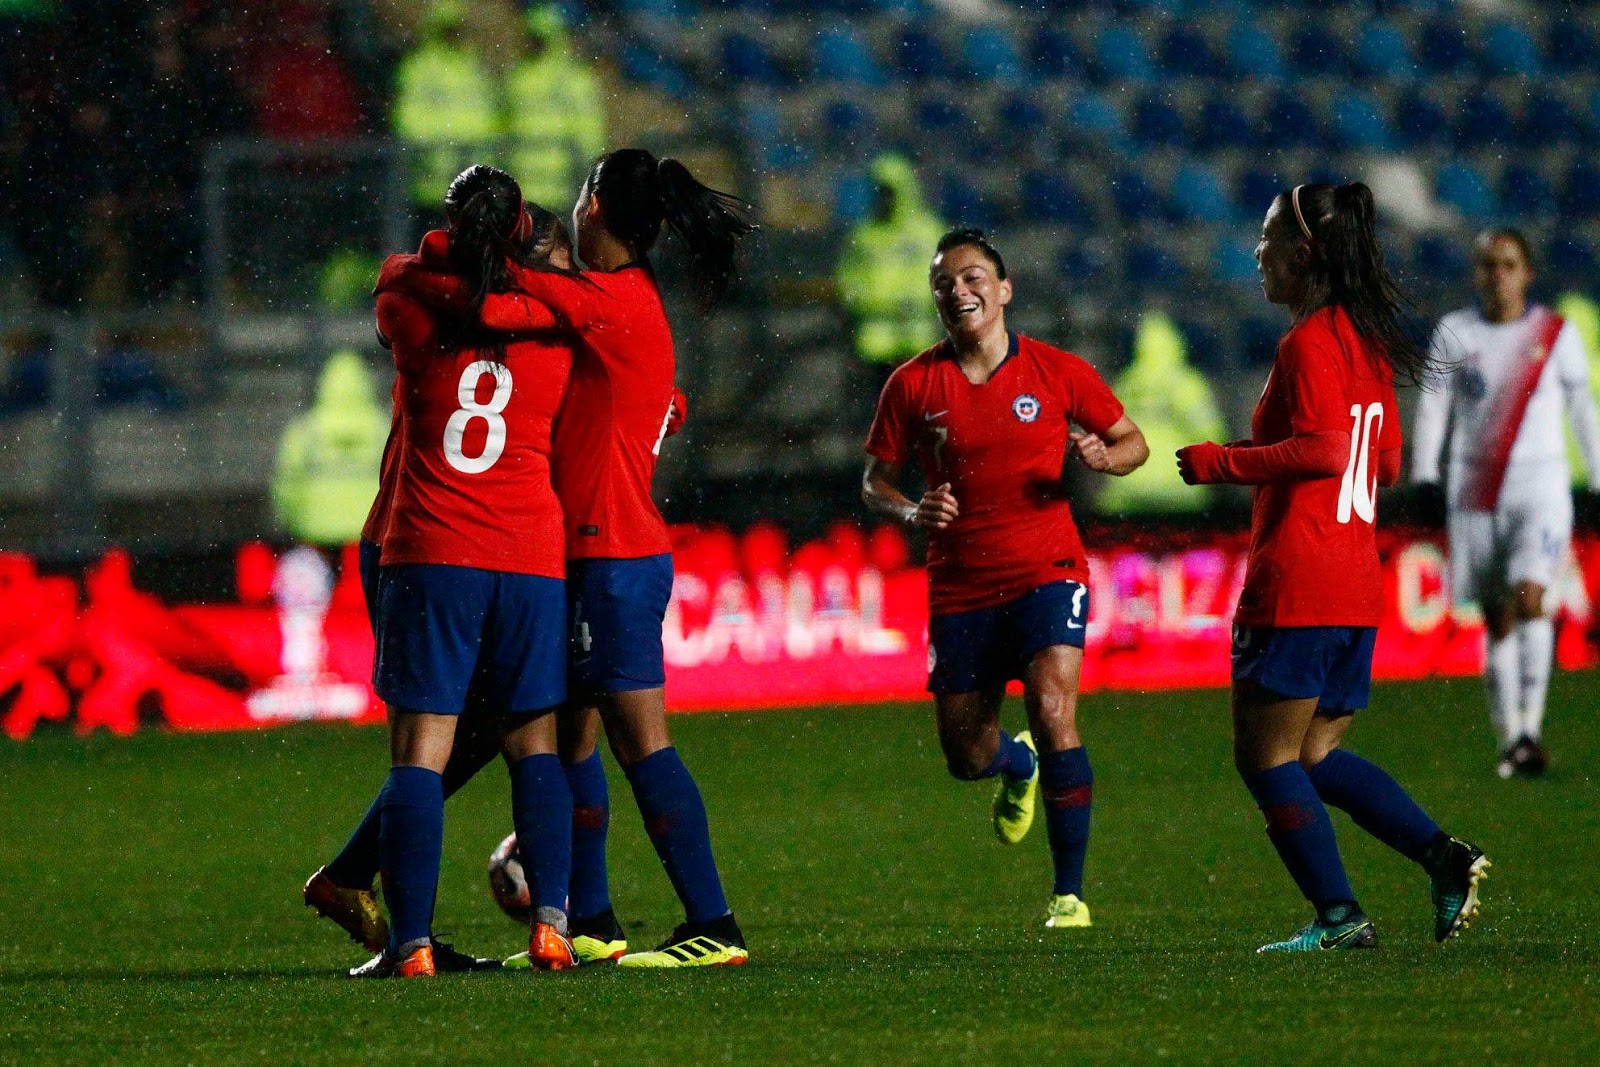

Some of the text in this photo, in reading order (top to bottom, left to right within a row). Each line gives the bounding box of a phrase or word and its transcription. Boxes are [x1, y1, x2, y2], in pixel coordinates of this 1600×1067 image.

[443, 360, 513, 474] 8
[1337, 402, 1384, 524] 10
[1065, 579, 1088, 618] 7
